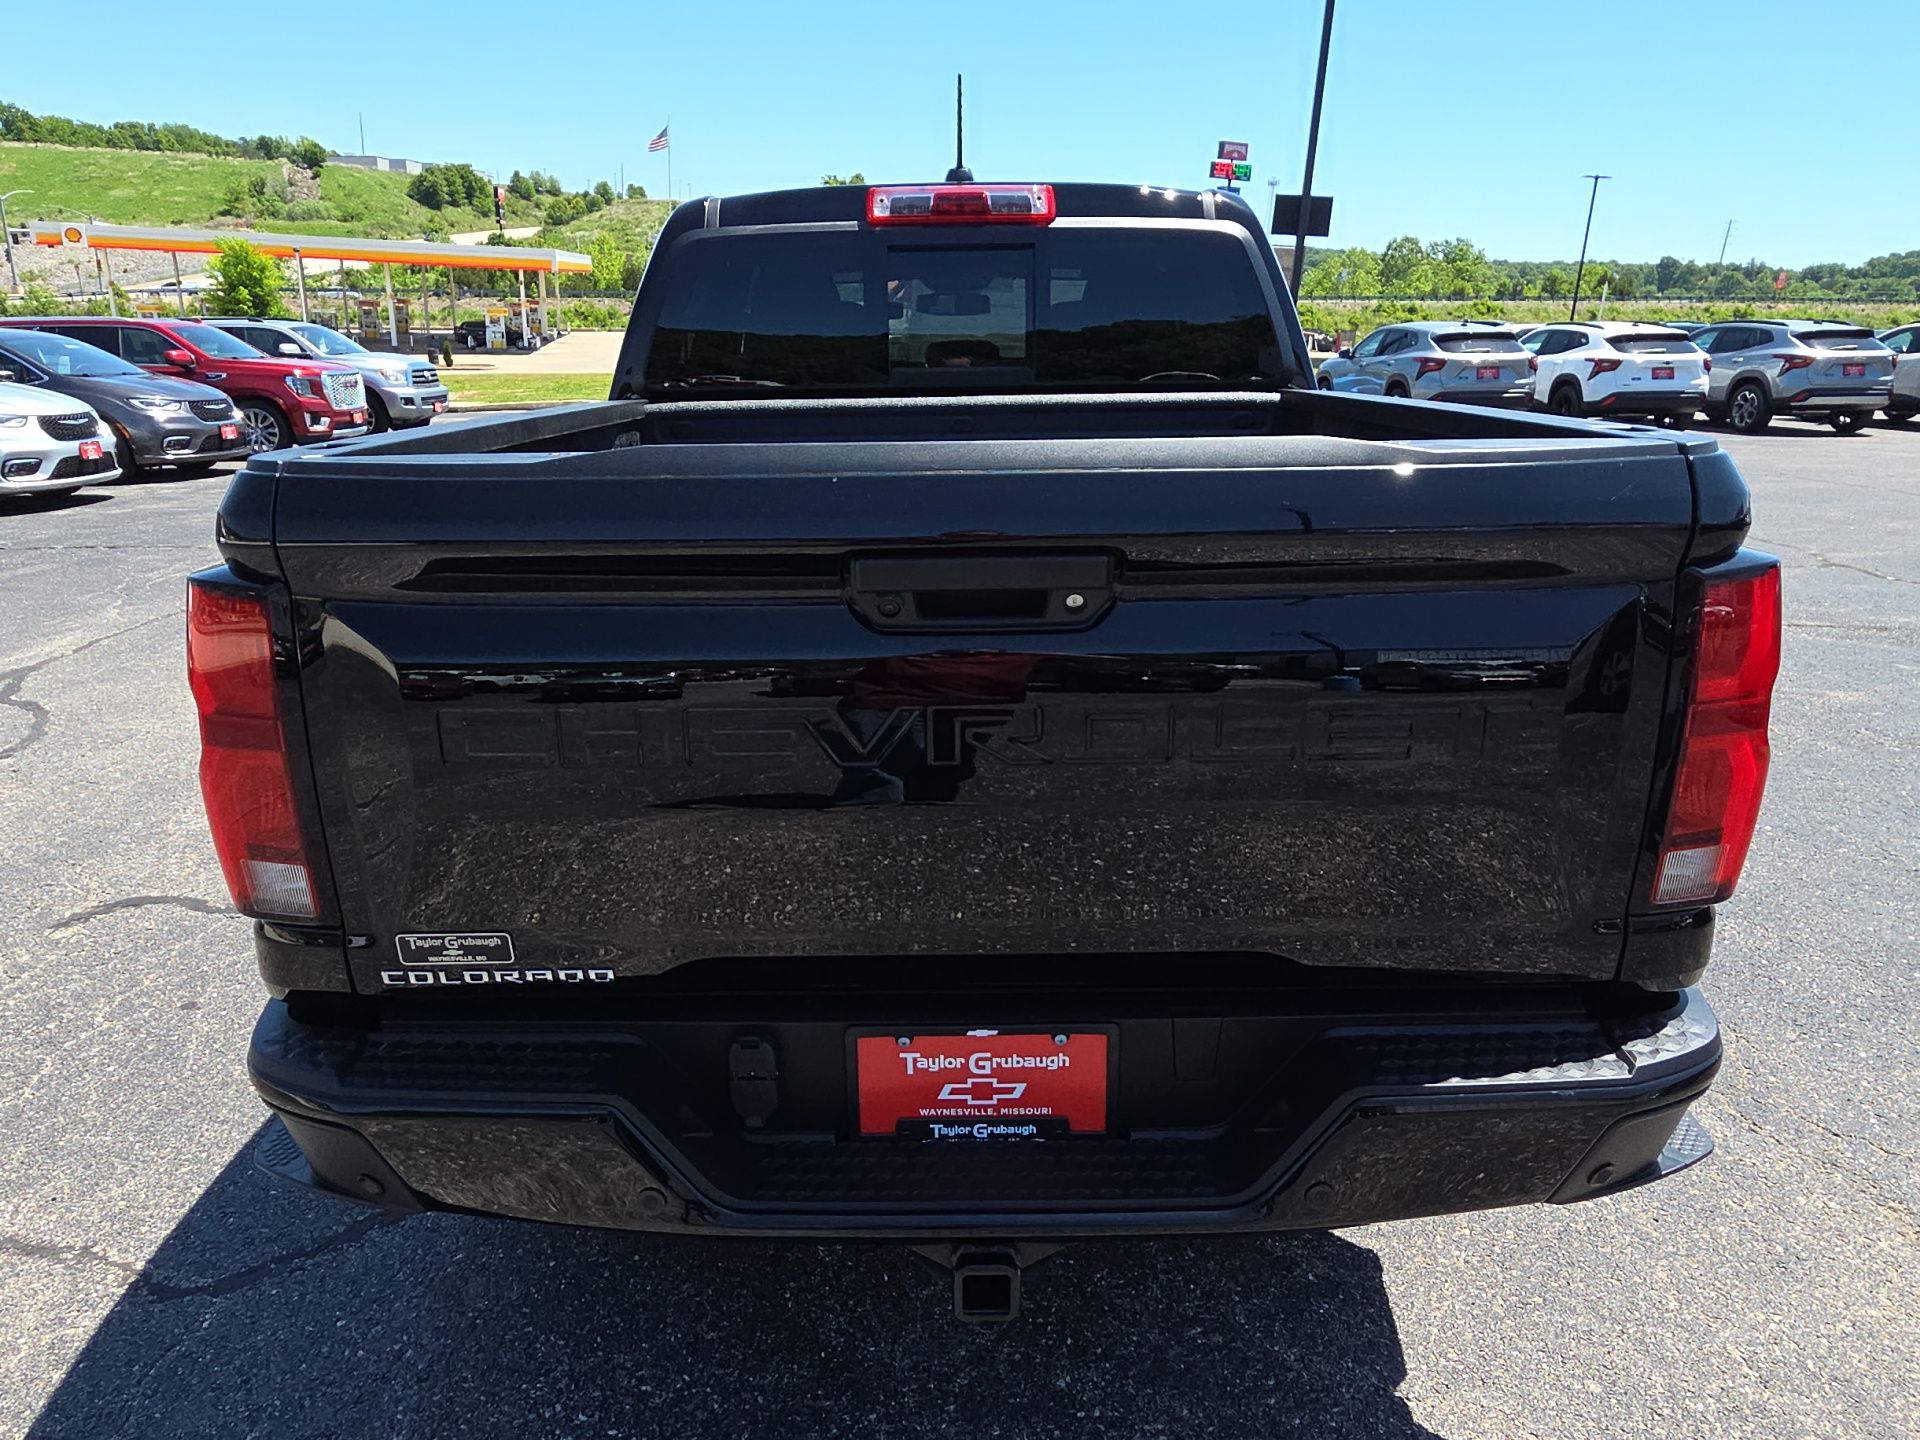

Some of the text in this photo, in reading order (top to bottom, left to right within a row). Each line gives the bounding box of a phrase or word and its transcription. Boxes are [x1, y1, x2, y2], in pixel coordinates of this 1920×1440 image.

[405, 936, 501, 950] Taylor Grubaugh
[381, 970, 614, 985] COLORADO
[899, 1052, 1070, 1075] Taylor Grubaugh
[919, 1106, 1052, 1117] WAYNESVILLE, MISSOURI
[929, 1123, 1037, 1138] Taylor Grubaugh
